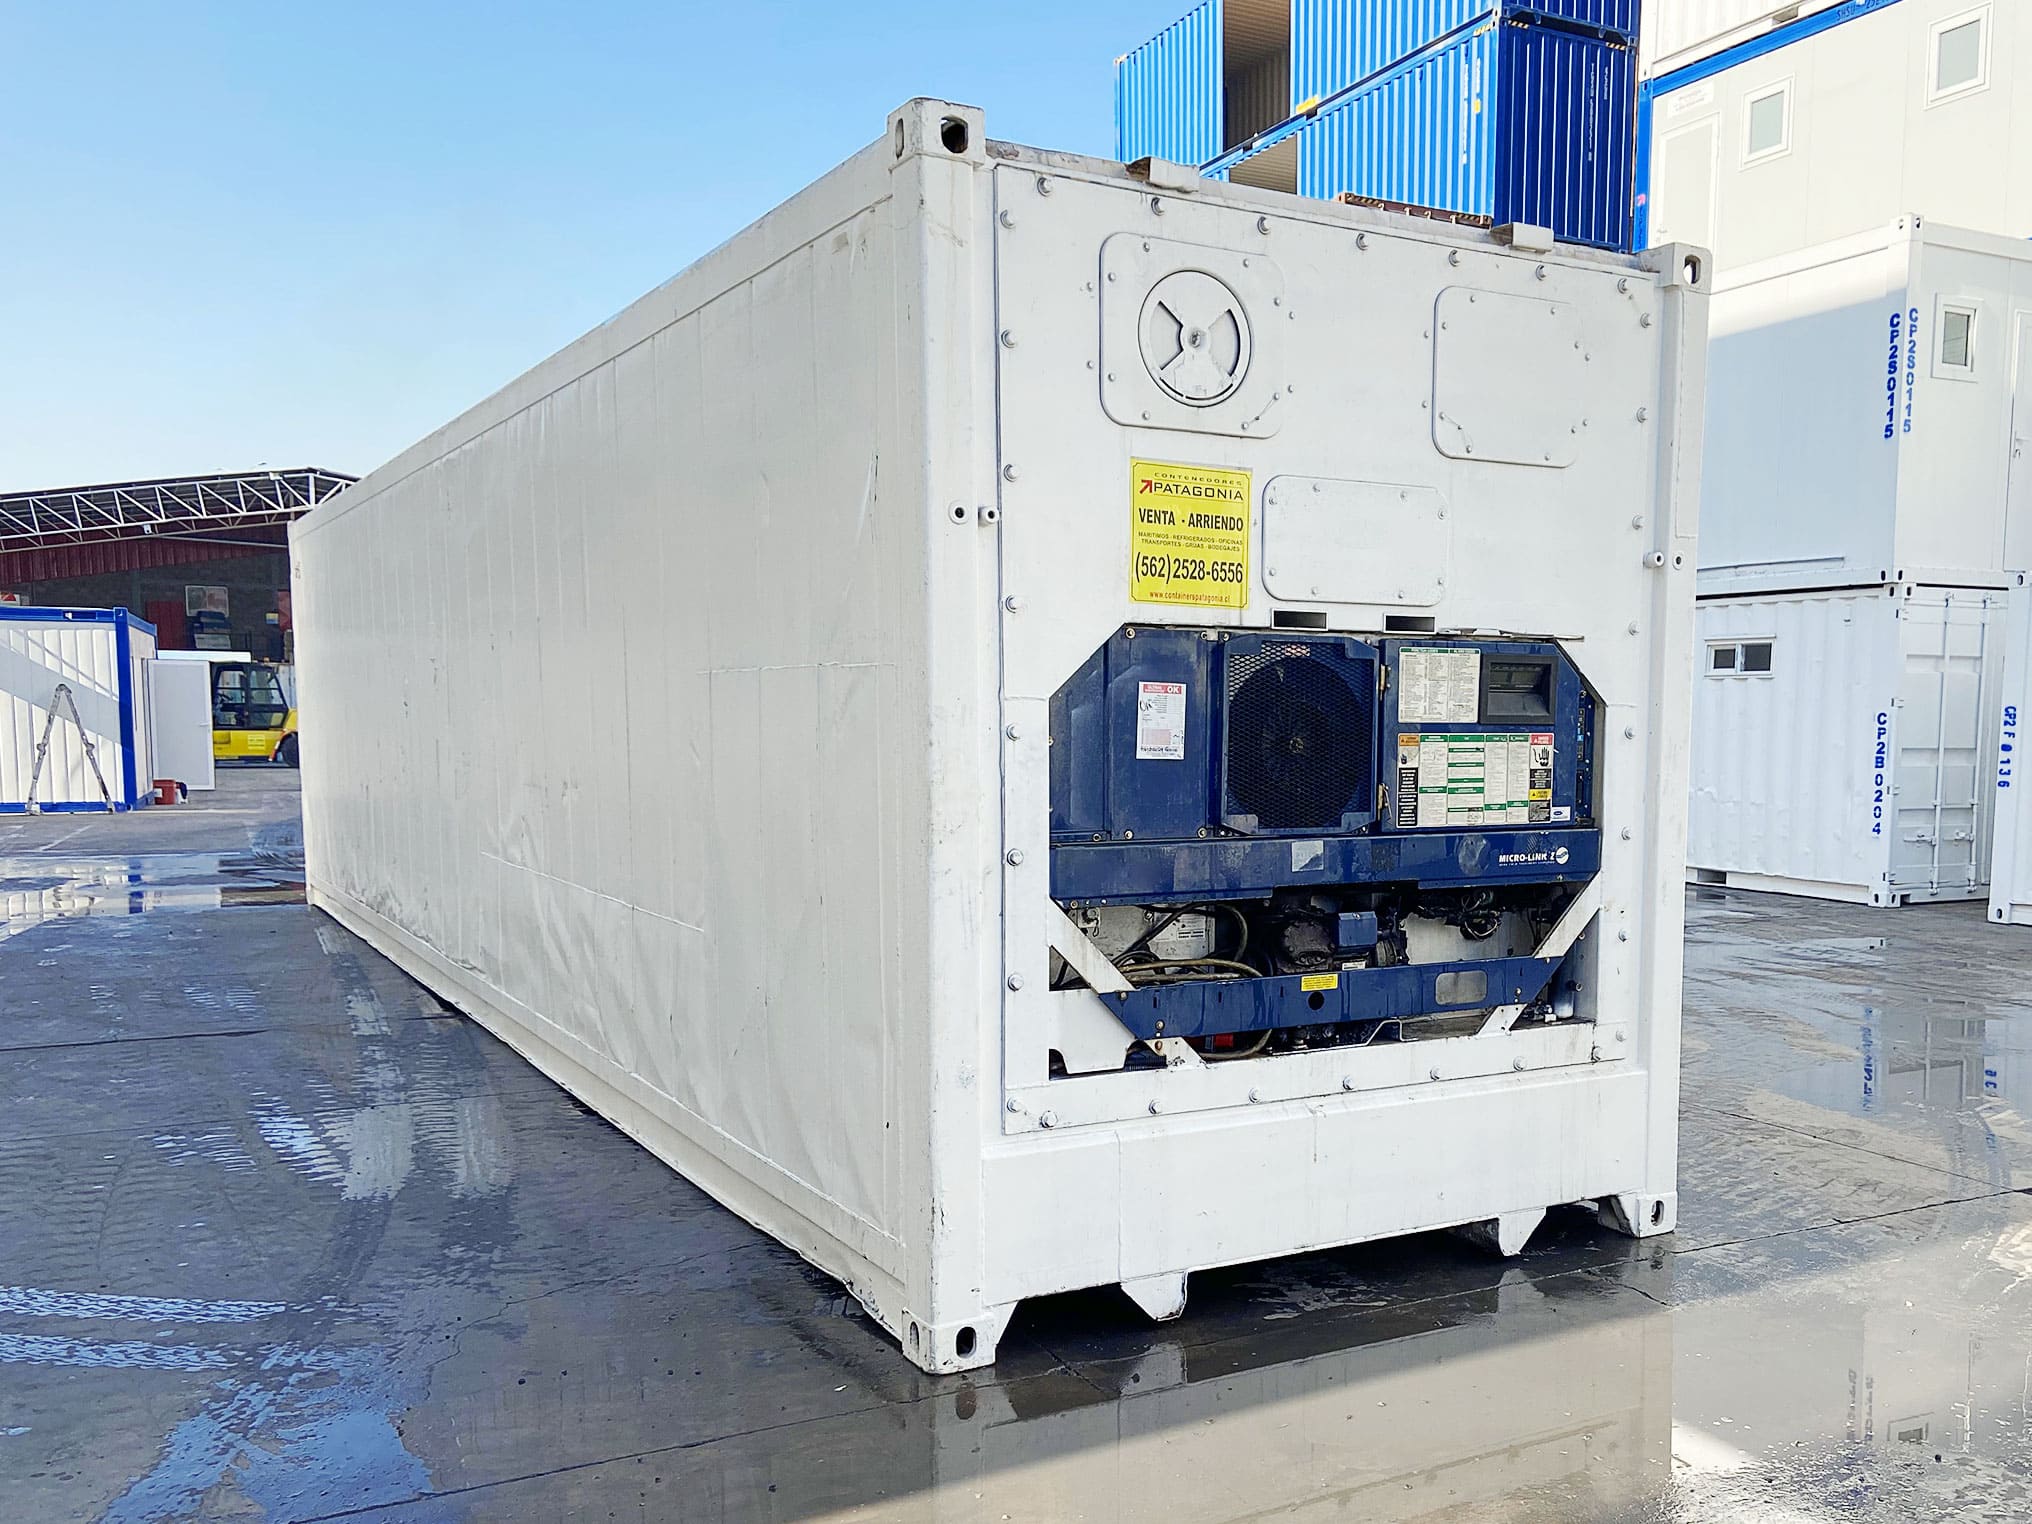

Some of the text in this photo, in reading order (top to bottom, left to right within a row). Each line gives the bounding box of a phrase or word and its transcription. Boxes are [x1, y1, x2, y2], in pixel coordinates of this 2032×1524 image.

[1884, 312, 1901, 439] CP2S0115
[1903, 307, 1919, 433] CP2S0115
[1154, 472, 1242, 486] CONTENEDORES
[1153, 482, 1244, 500] PATAGONIA
[1138, 507, 1244, 532] VENTA ARRIENDO
[1141, 538, 1182, 548] TRANSPORTES
[1172, 534, 1215, 544] REFRIGERADOS
[1218, 537, 1243, 546] OFICINAS
[1872, 712, 1888, 836] CP2B0204
[1499, 853, 1547, 863] MICRO-LINK
